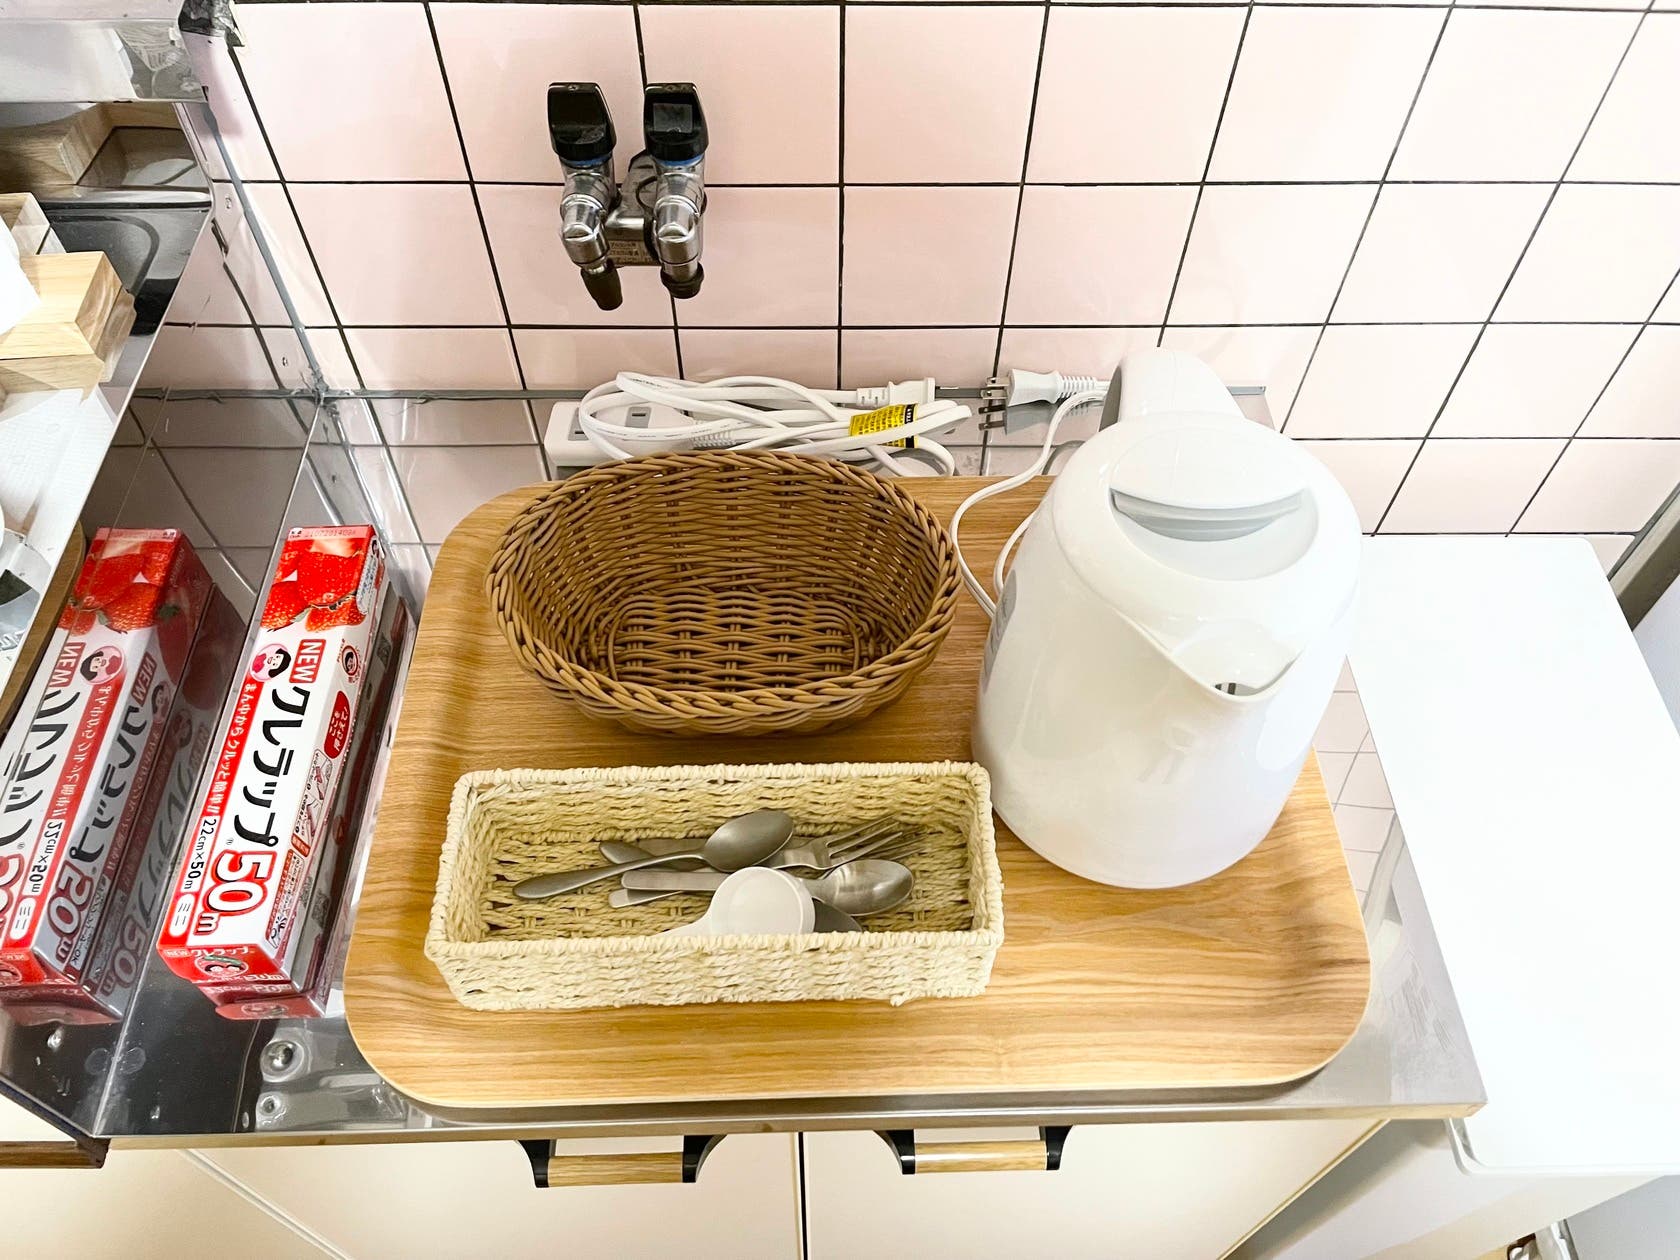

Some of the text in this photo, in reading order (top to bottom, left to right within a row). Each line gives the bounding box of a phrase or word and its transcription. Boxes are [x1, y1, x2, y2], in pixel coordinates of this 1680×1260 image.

[292, 641, 324, 682] NEW
[234, 686, 311, 847] クレラップ
[175, 903, 190, 927] ミニ
[193, 850, 277, 935] 50m
